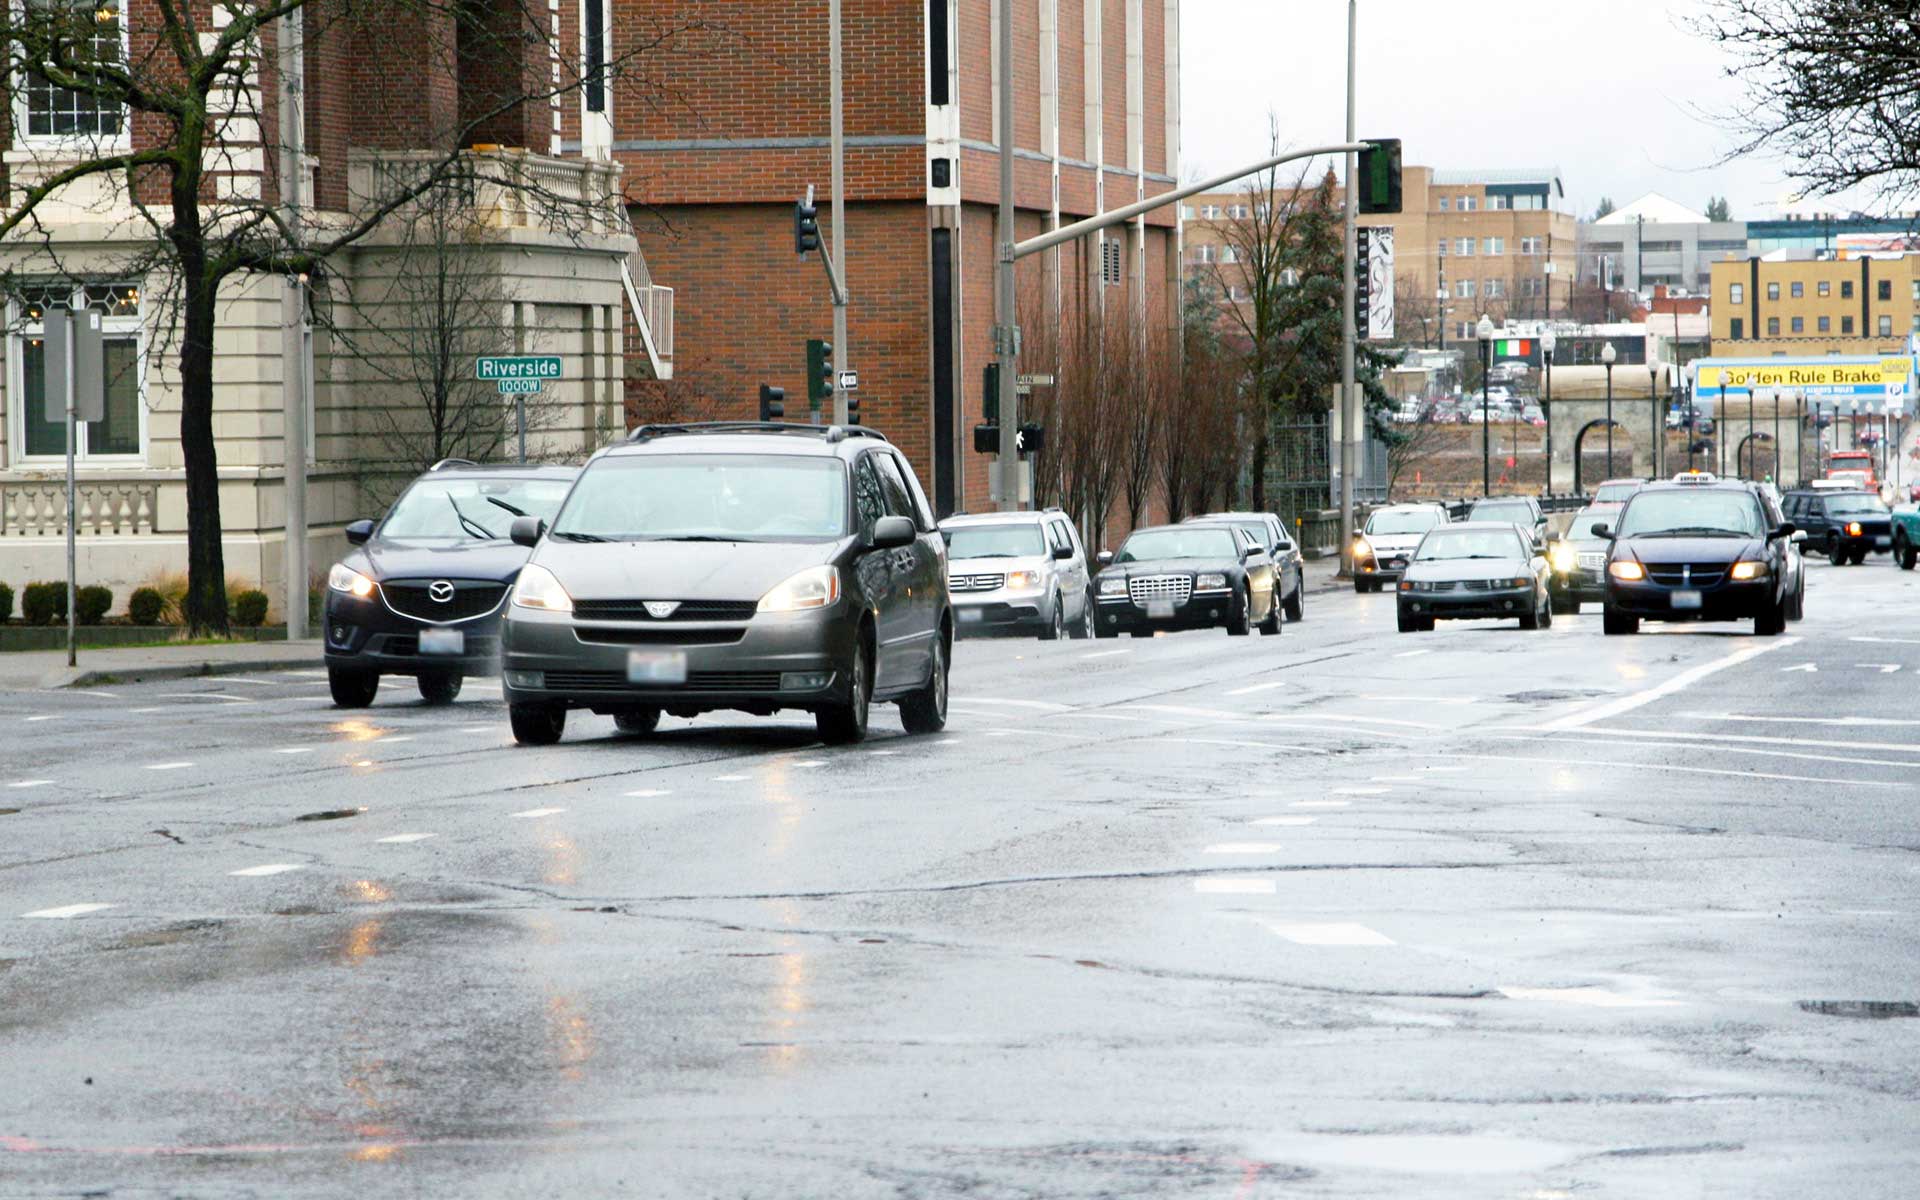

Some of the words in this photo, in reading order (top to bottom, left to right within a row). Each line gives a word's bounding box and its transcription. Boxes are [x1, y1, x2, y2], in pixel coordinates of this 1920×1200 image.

[1359, 232, 1368, 332] DOWNTOWN
[482, 360, 558, 376] Riverside
[1725, 371, 1783, 385] Golden
[1789, 370, 1826, 384] Rule
[1833, 369, 1881, 383] Brake
[501, 381, 538, 392] 1000W
